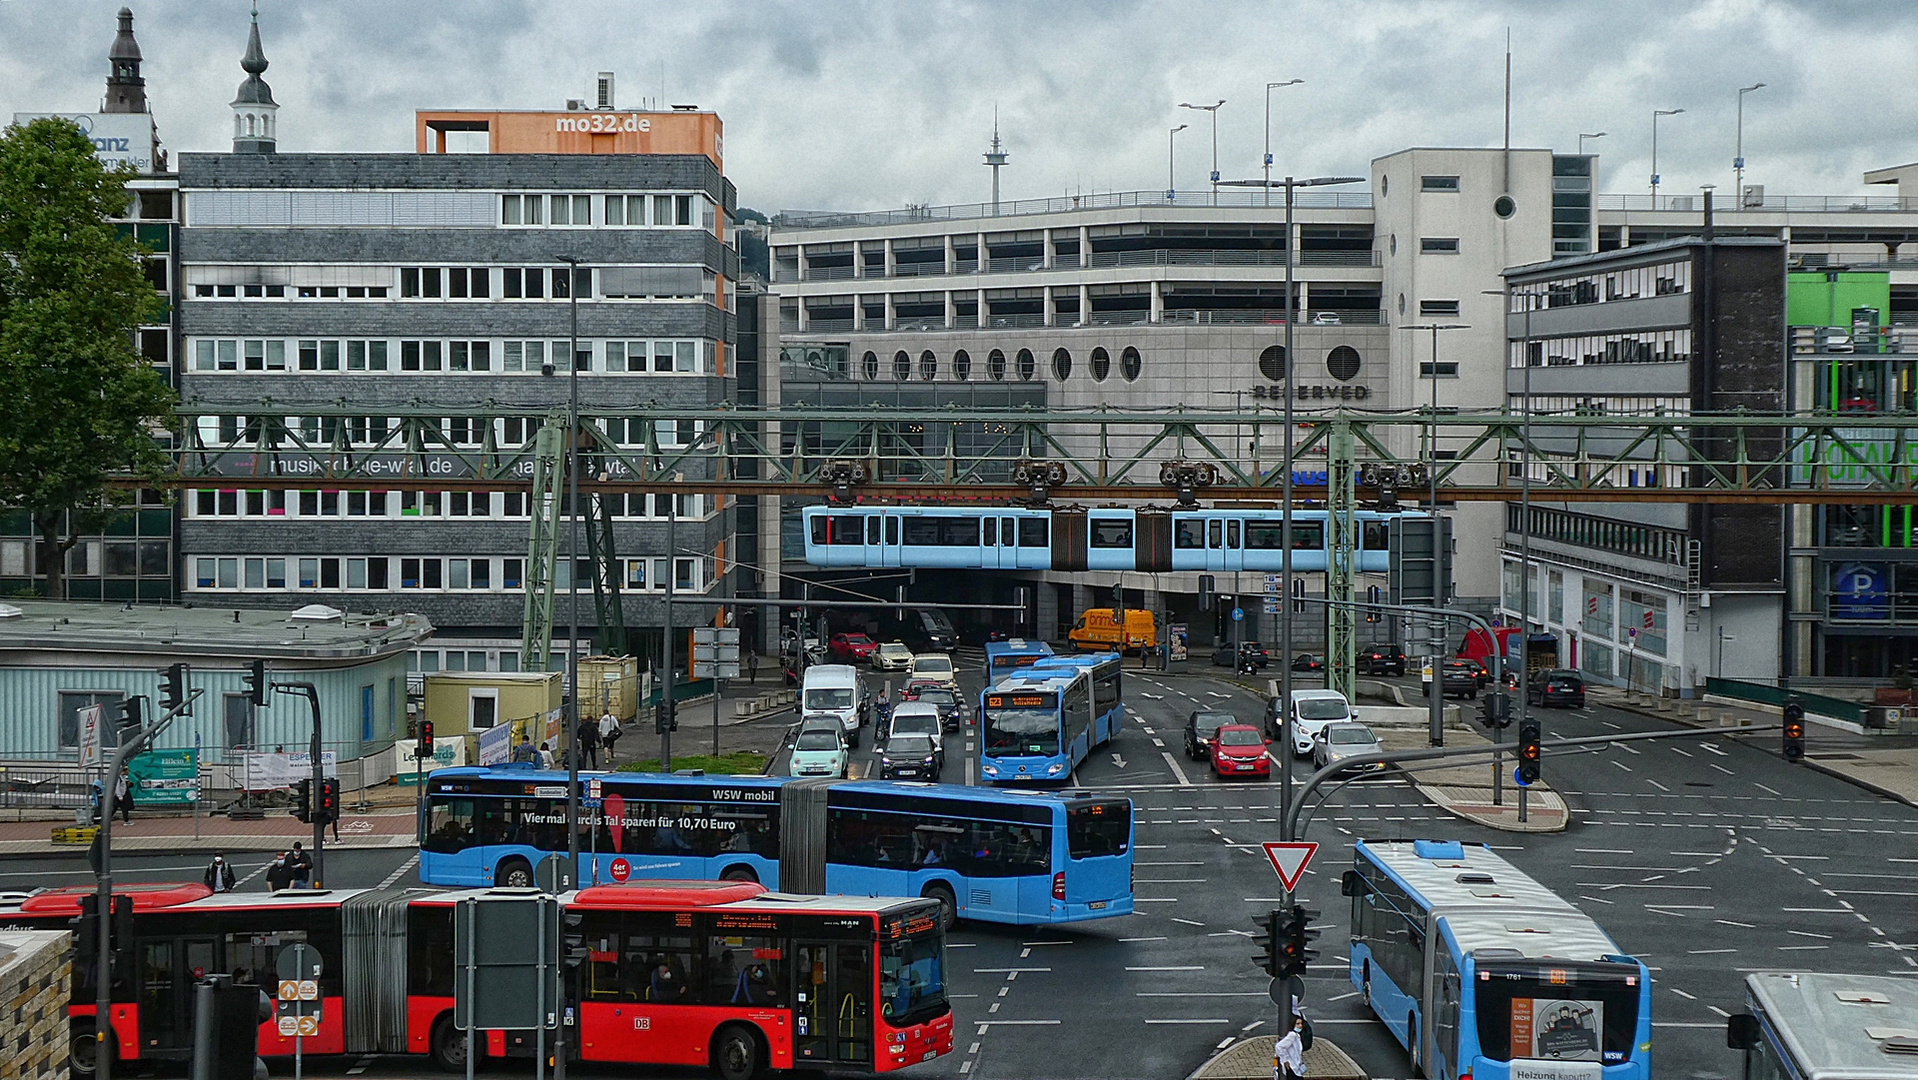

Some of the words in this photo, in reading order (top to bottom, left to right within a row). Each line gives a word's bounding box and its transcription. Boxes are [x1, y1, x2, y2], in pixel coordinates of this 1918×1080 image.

[556, 114, 650, 132] mo32.de
[1255, 386, 1367, 400] REERVED
[1854, 574, 1872, 598] P
[989, 697, 1002, 707] 623
[403, 750, 454, 761] Leards
[712, 789, 741, 799] WSW
[744, 790, 775, 801] mobil
[524, 813, 545, 823] Vier
[547, 813, 565, 824] mal
[567, 815, 602, 826] urchs
[604, 815, 618, 826] Tal
[621, 817, 655, 829] sparen
[658, 816, 674, 828] für
[678, 818, 708, 830] 10,70
[710, 819, 736, 830] Euro
[635, 1018, 649, 1029] DB
[1604, 1051, 1623, 1060] WSW
[1517, 1071, 1556, 1080] Heizung
[1558, 1072, 1592, 1080] kaputt?
